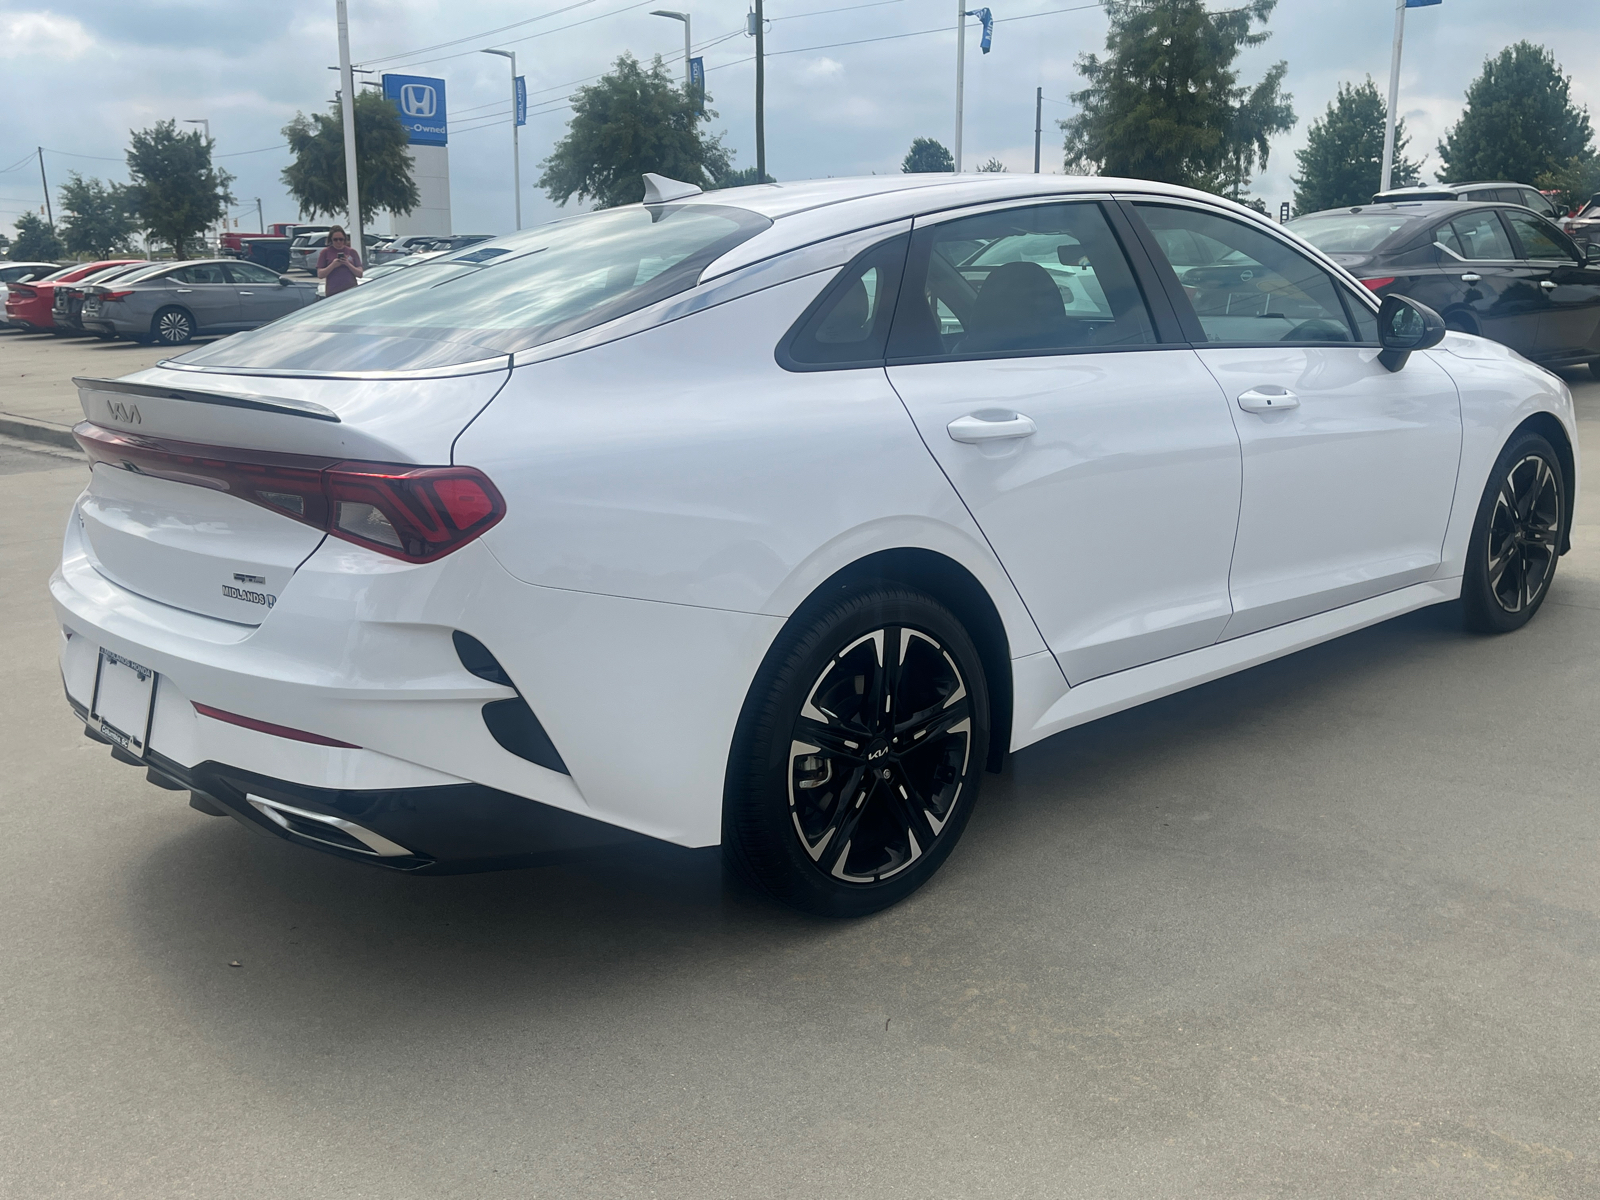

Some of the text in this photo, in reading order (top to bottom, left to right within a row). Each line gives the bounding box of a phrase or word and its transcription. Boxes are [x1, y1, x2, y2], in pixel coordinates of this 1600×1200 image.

[402, 123, 446, 134] e-Owned
[107, 400, 142, 425] KIA
[222, 584, 266, 605] MIDLANDS
[104, 649, 151, 677] MIDLANDS HONDA
[121, 738, 128, 748] SC
[868, 746, 889, 760] KIA
